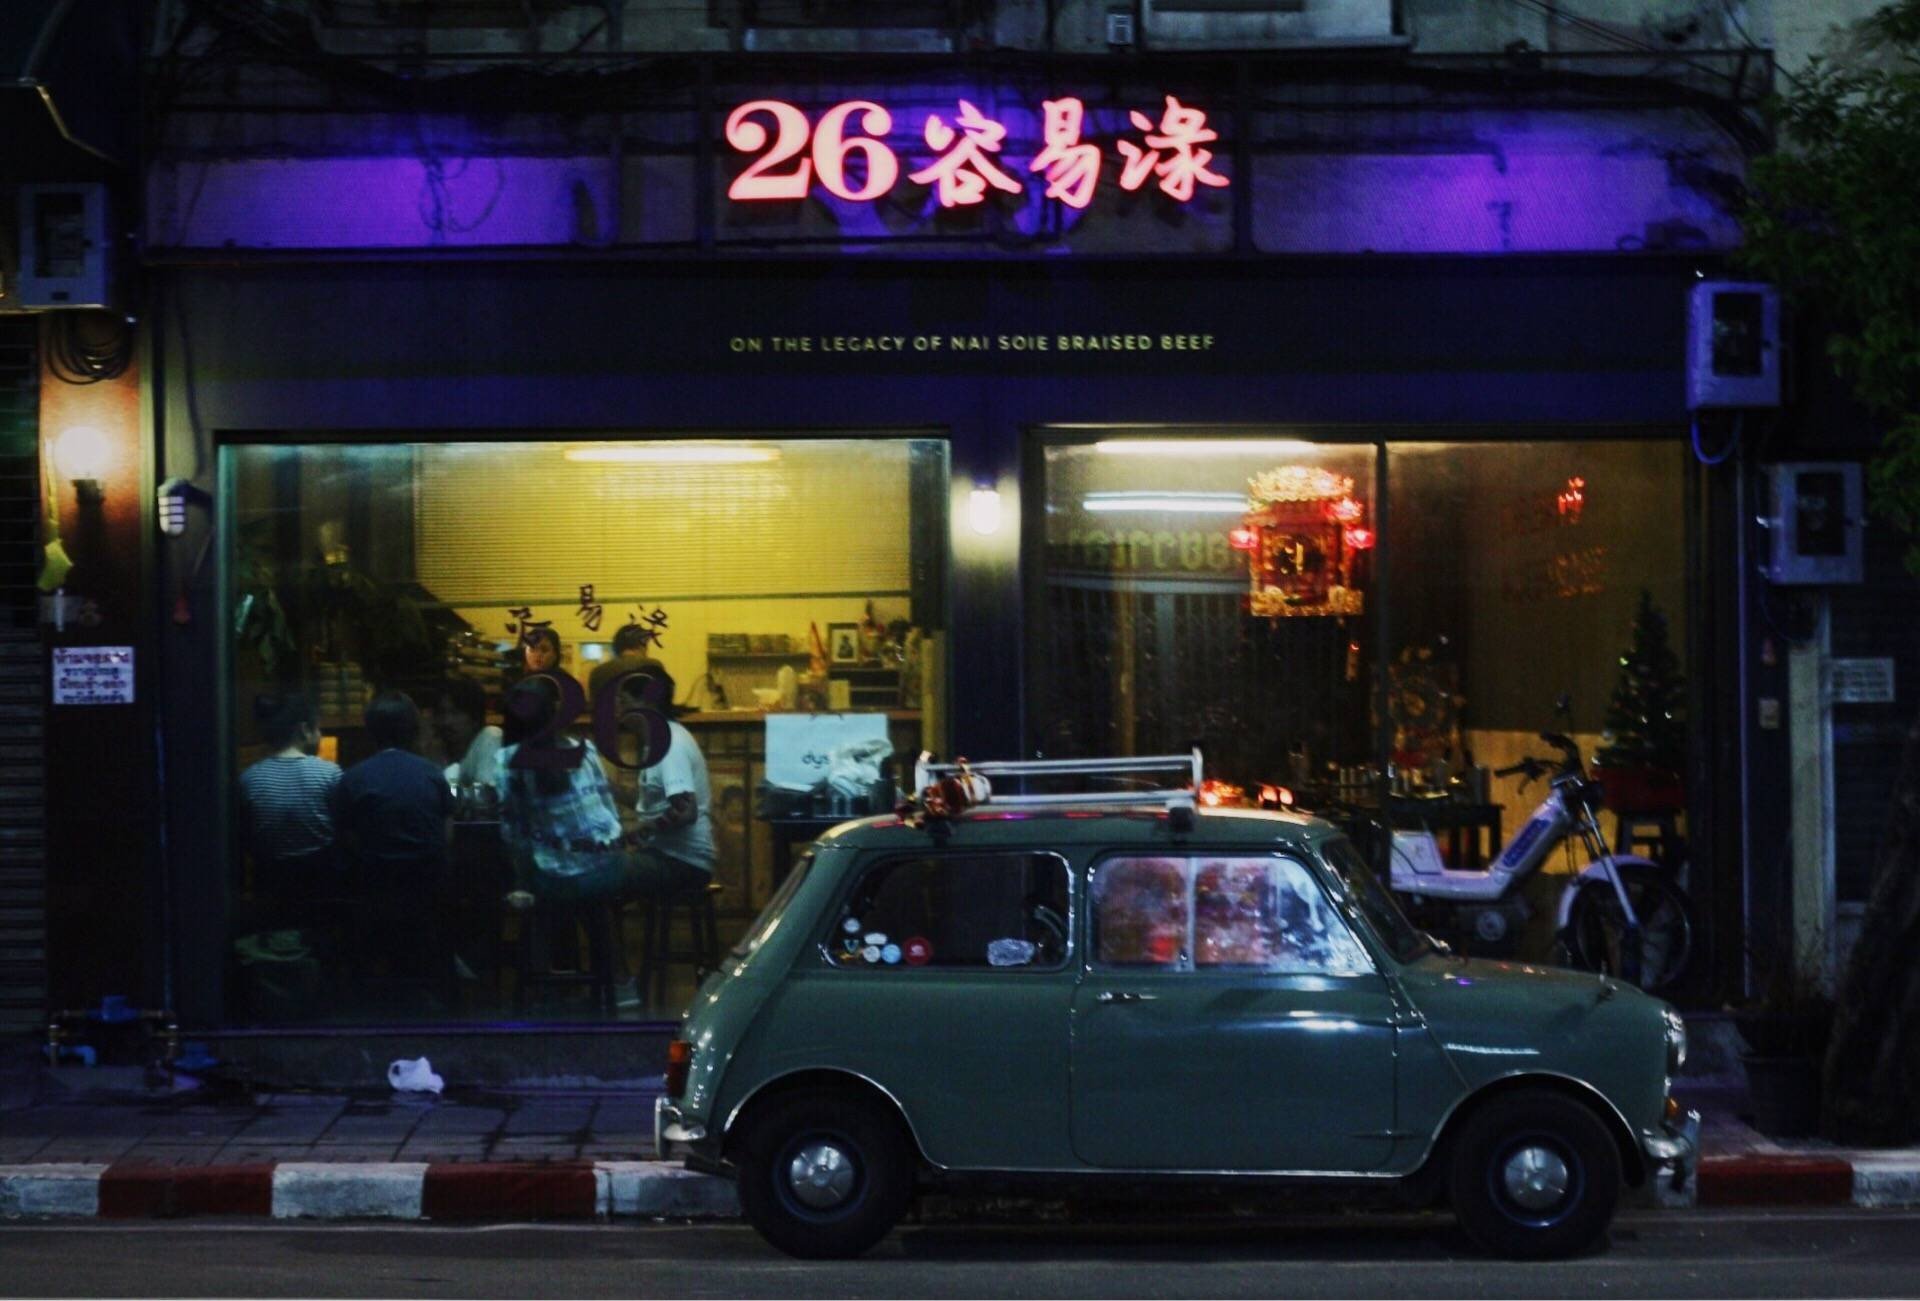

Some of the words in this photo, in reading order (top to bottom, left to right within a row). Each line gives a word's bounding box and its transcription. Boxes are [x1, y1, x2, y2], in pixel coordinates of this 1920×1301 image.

[725, 100, 899, 201] 26
[730, 336, 762, 352] ON
[771, 336, 812, 351] THE
[820, 336, 905, 351] LEGACY
[913, 335, 942, 351] OF
[951, 335, 989, 351] NAI
[998, 335, 1049, 350] SOIE
[1057, 335, 1152, 350] BRAISED
[1160, 335, 1214, 350] BEEF
[508, 671, 671, 770] 26
